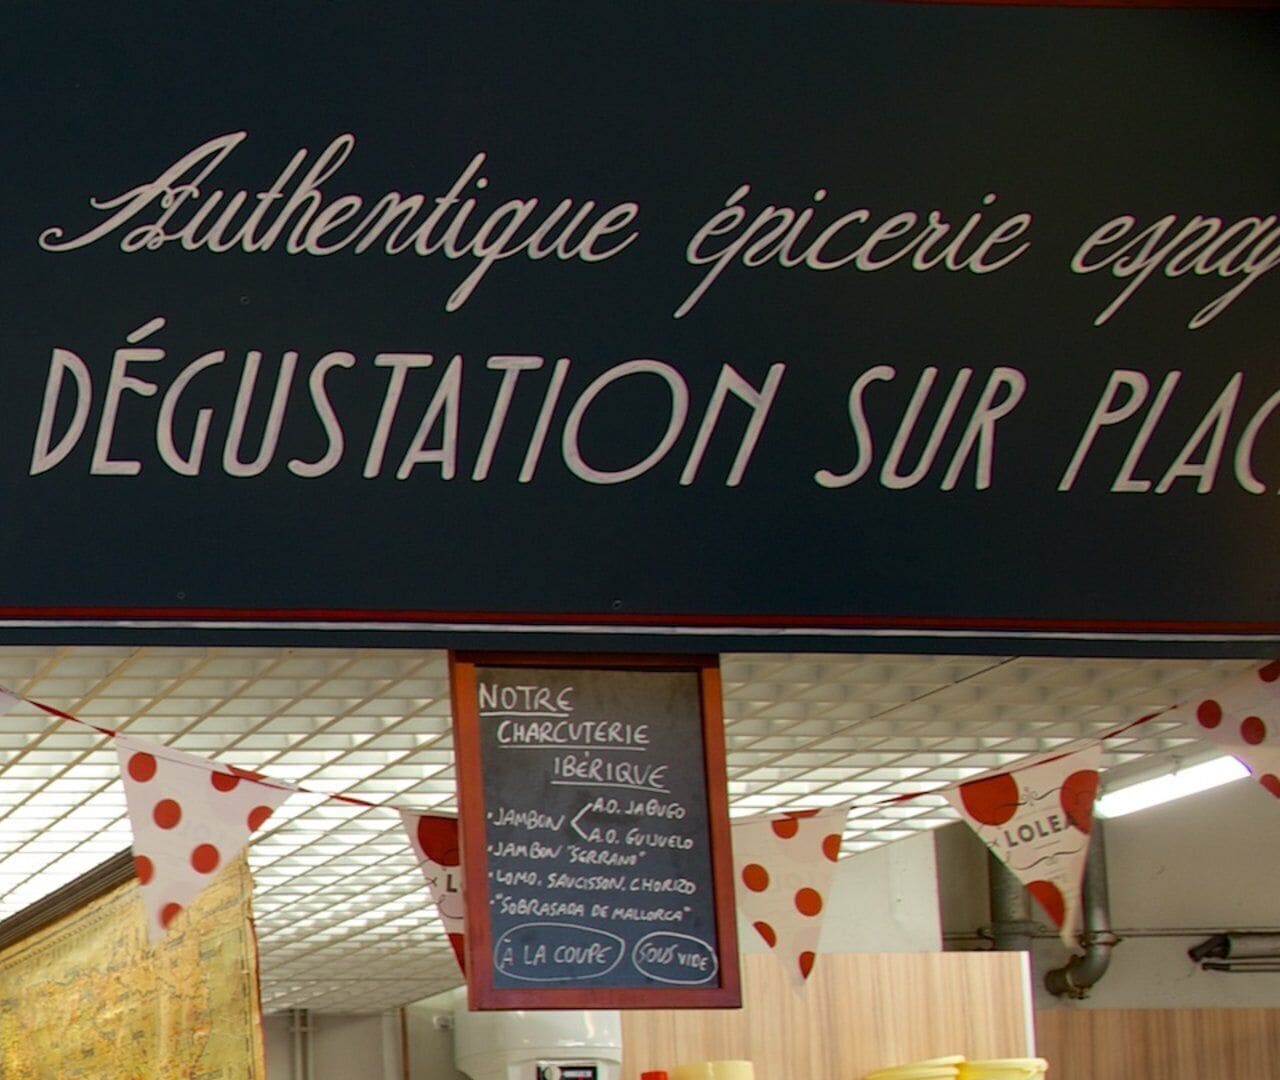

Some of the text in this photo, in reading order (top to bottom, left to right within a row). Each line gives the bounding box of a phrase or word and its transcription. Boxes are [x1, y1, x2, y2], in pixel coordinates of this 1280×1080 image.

[38, 130, 639, 312] Authentique
[674, 183, 1032, 319] épicerie
[29, 317, 786, 487] DÉGUSTATION
[814, 365, 1026, 491] SUR
[479, 683, 574, 712] NOTRE
[497, 720, 650, 745] CHARCUTERIE
[493, 808, 566, 832] JAMBON
[493, 841, 561, 860] JAMBON
[630, 876, 696, 895] CHORIZO
[592, 902, 608, 918] DE
[523, 945, 547, 965] LA
[554, 943, 612, 965] COUPE
[639, 943, 678, 965] SOUS
[677, 953, 709, 971] VIDE
